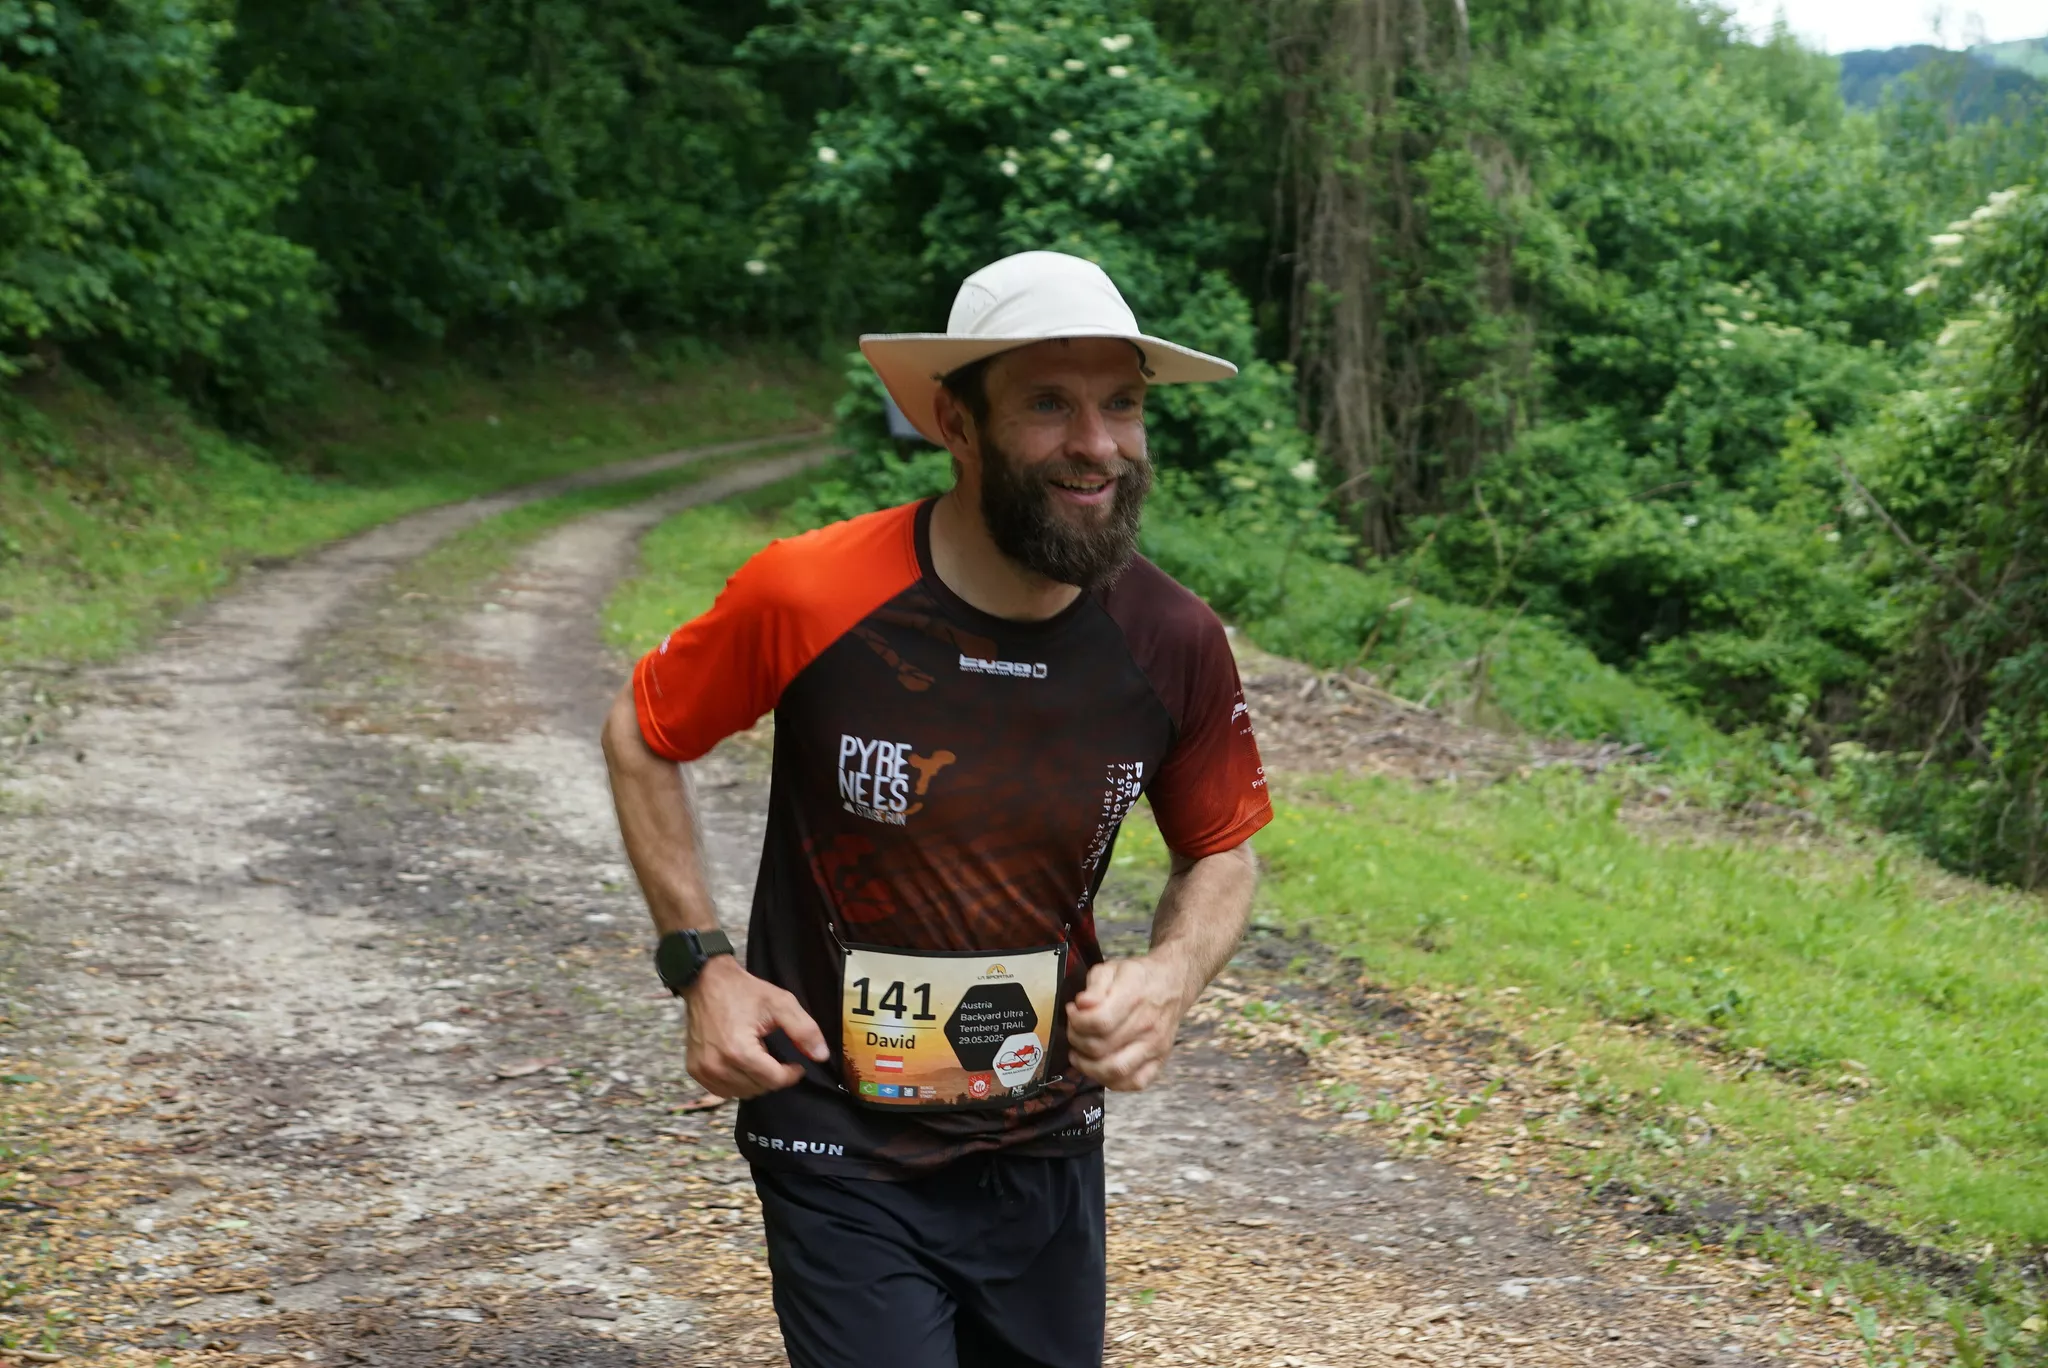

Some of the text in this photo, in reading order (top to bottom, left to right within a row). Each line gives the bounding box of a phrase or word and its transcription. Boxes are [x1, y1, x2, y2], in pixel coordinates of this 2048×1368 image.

[839, 734, 913, 780] PYRE
[838, 767, 909, 813] NEES
[1101, 790, 1113, 817] SEPT
[852, 977, 936, 1020] 141
[960, 1001, 993, 1010] Austria
[960, 1012, 1001, 1022] Backyard
[1003, 1010, 1024, 1019] Ultra
[959, 1021, 1026, 1033] Ternberg TRAIL
[866, 1032, 916, 1050] David
[958, 1034, 1005, 1045] 29.05.2025
[747, 1131, 844, 1156] PSR.RUN
